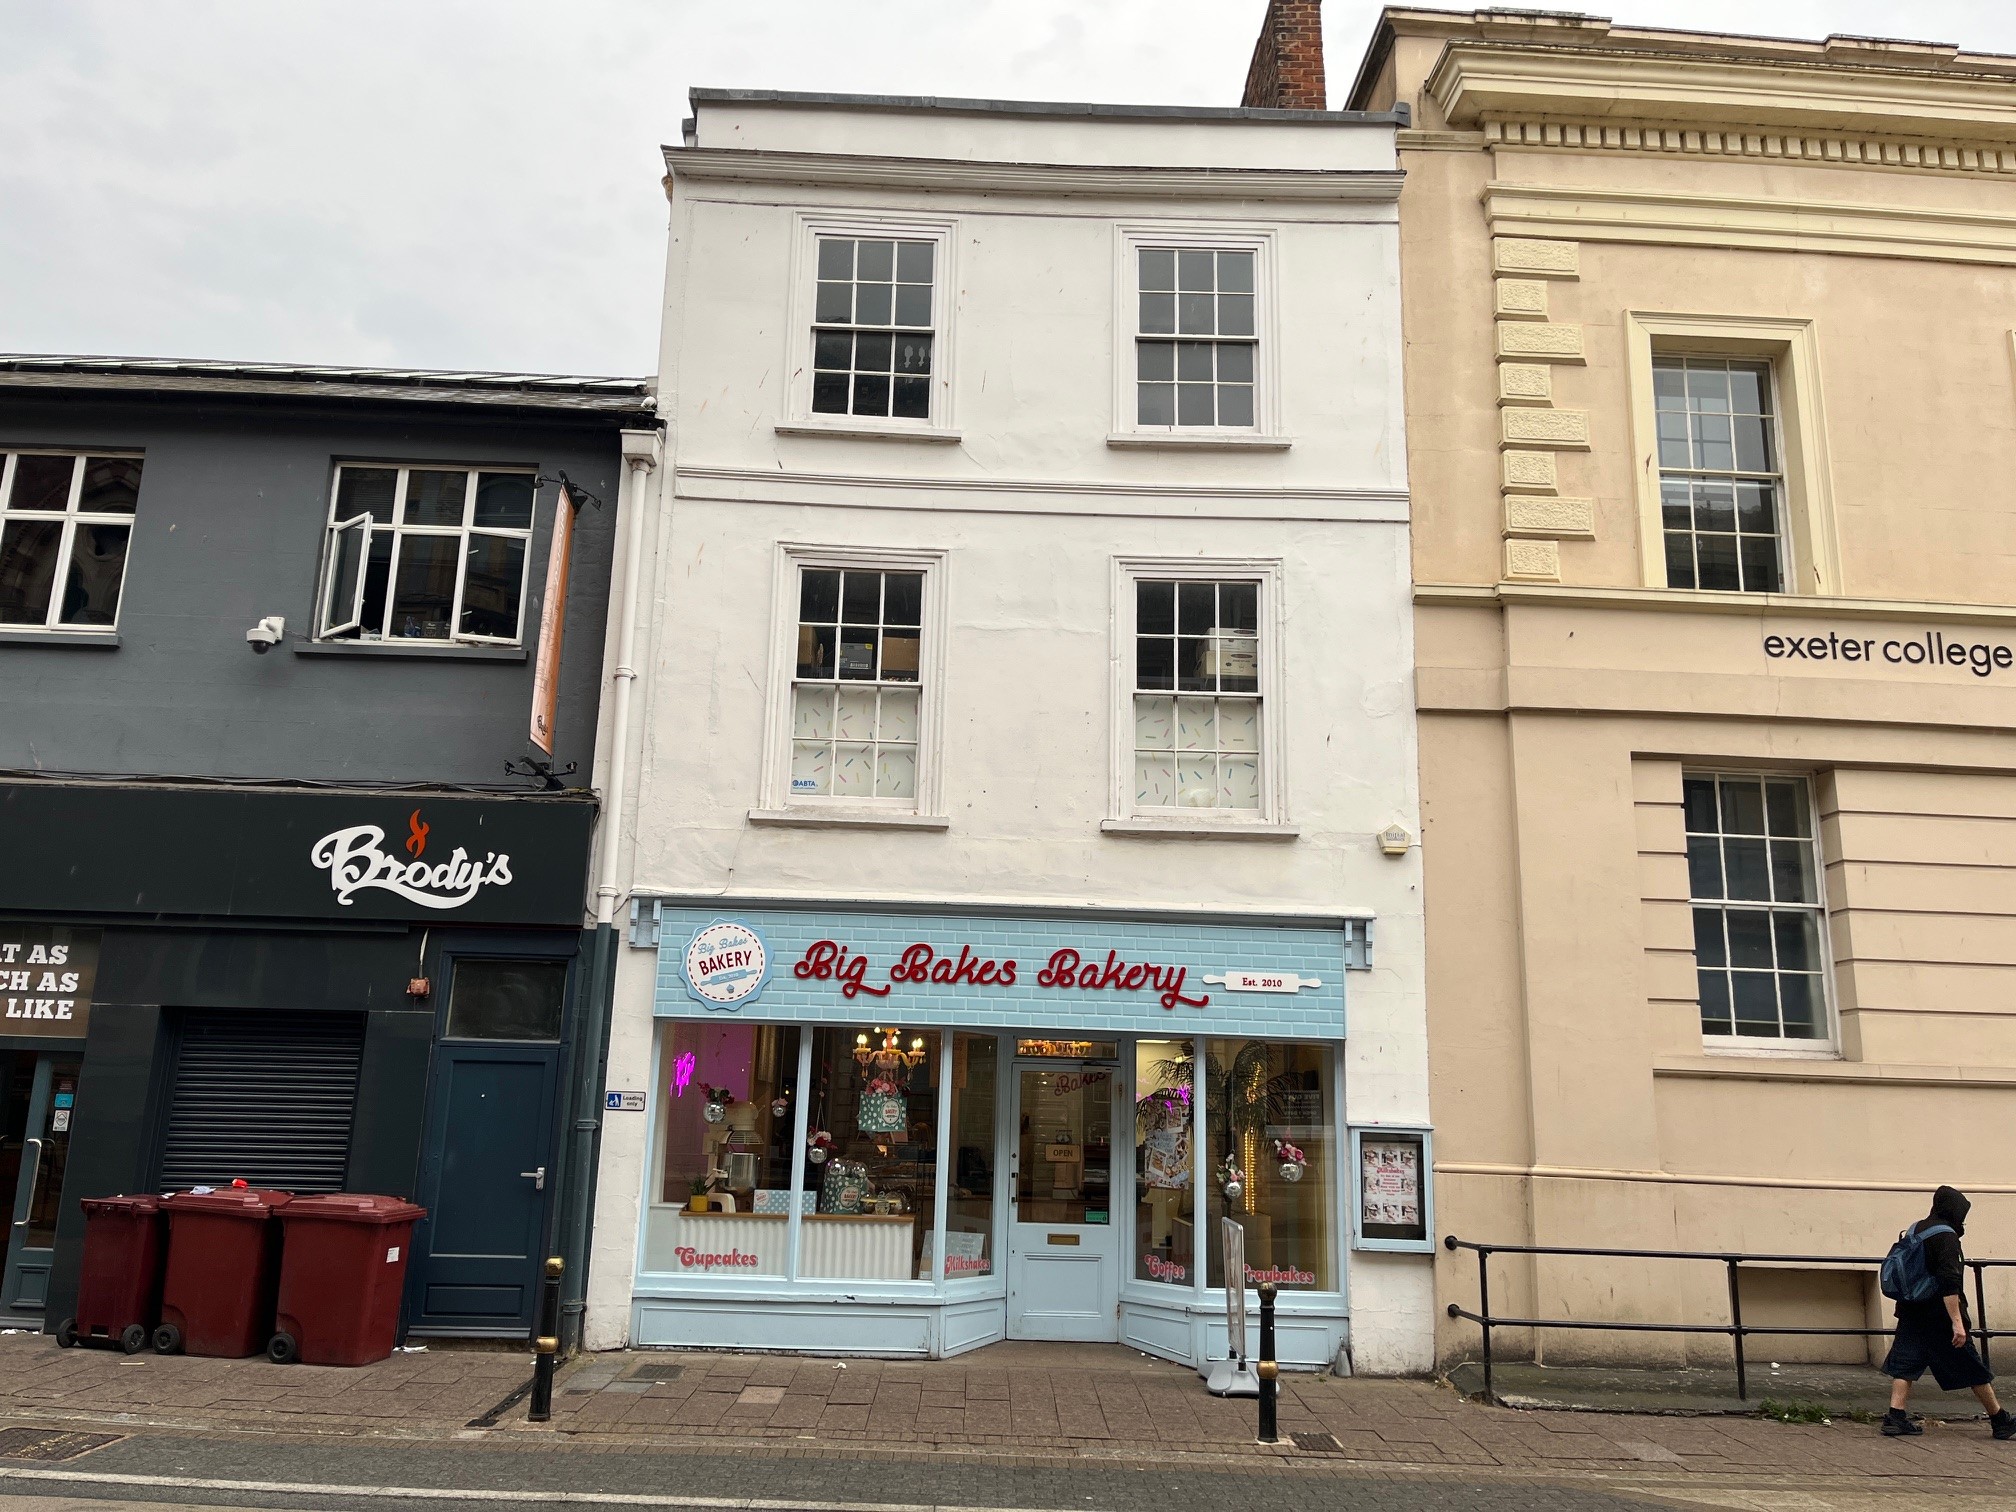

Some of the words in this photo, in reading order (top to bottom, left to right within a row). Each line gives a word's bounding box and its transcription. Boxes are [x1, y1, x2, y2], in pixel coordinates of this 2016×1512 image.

[1764, 632, 1875, 661] exeter
[1883, 632, 2013, 677] college
[311, 825, 513, 909] Brody's
[0, 943, 21, 963] T
[26, 944, 69, 965] AS
[697, 943, 715, 956] Big
[719, 936, 748, 949] Bakes
[698, 950, 752, 976] BAKERY
[36, 972, 79, 992] AS
[794, 940, 891, 998] Big
[890, 943, 1017, 986] Bakes
[1037, 948, 1210, 1009] Bakery
[1242, 977, 1258, 986] Est.
[1262, 978, 1282, 987] 2010
[5, 998, 75, 1019] LIKE
[1053, 1149, 1073, 1157] OPEN
[674, 1246, 759, 1272] Cupcakes
[944, 1254, 991, 1275] Milkshakes
[1144, 1254, 1186, 1282] Coffee
